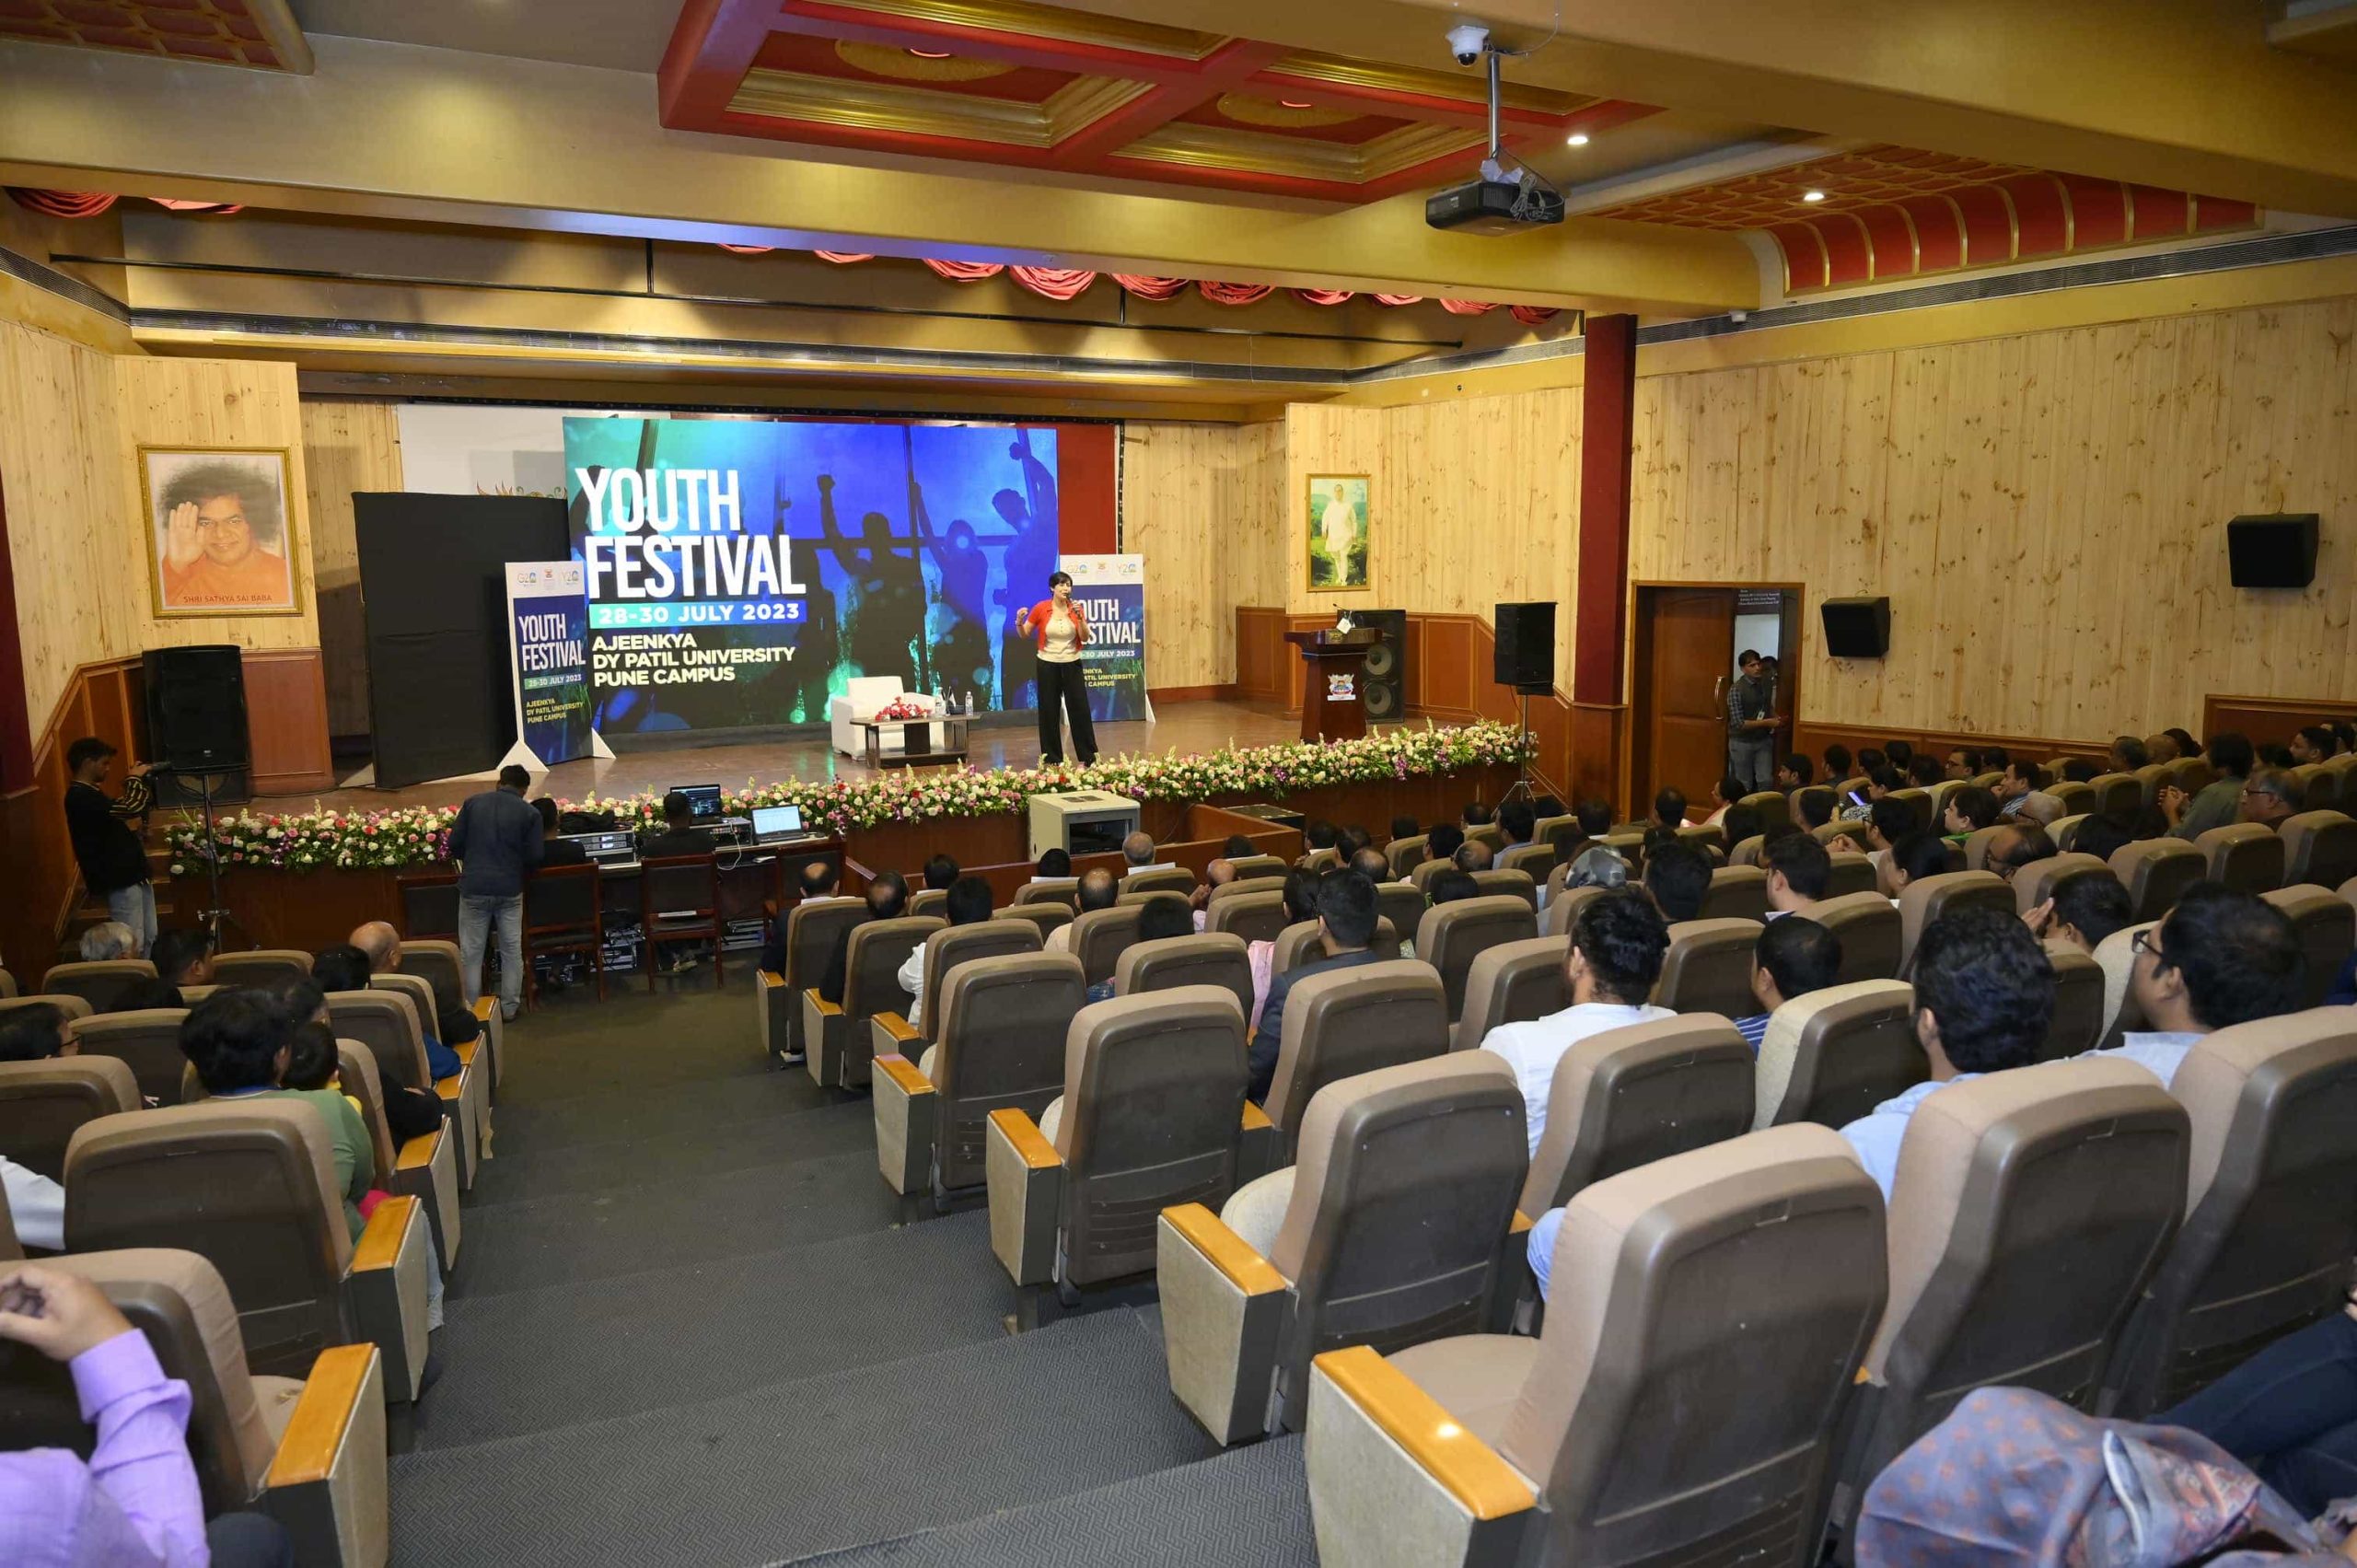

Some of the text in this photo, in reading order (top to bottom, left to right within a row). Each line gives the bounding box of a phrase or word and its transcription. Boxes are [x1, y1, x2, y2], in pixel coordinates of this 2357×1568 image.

[575, 468, 741, 532] YOUTH
[584, 534, 807, 599] FESTIVAL
[599, 603, 799, 625] 28-30 JULY 2023
[1077, 599, 1120, 621] OUTH
[518, 613, 566, 643] YOUTH
[1081, 621, 1141, 645] STIVAL
[592, 633, 698, 652] AJEENKYA
[521, 640, 586, 671] FESTIVAL
[593, 646, 796, 669] DY PATIL UNIVERSITY
[528, 673, 582, 687] 28-30 JULY 2023
[594, 666, 736, 687] PUNE CAMPUS
[526, 698, 556, 708] AJEENKYA
[535, 706, 552, 715] PATIL
[552, 701, 584, 713] UNIVERSITY
[527, 712, 567, 724] PUNE CAMPUS
